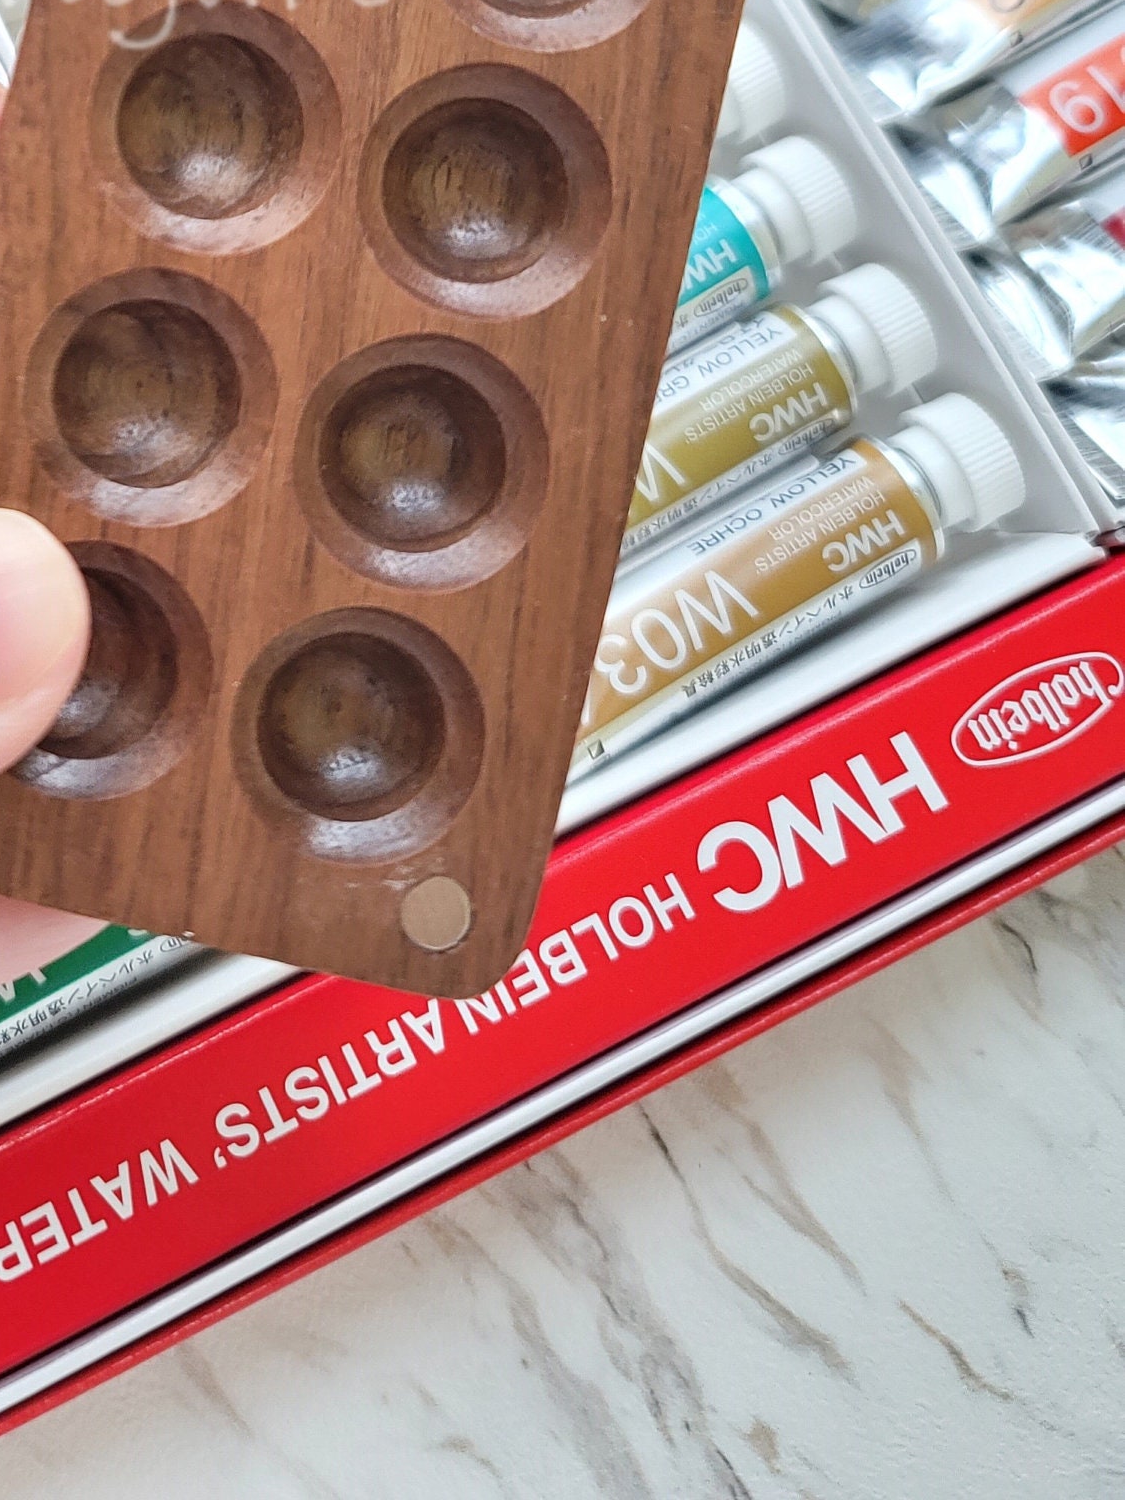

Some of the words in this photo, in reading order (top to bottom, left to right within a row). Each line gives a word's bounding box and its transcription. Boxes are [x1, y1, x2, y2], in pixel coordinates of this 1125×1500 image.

[1049, 47, 1125, 135] 19
[681, 239, 736, 292] HW
[699, 325, 782, 378] YELLOW
[699, 348, 802, 412] WATERCOLOR
[746, 362, 813, 407] HOLBEIN
[748, 381, 828, 441] HWC
[769, 455, 855, 508] YELLOW
[769, 474, 874, 542] WATERCOLOR
[817, 490, 885, 535] HOLBEIN
[691, 508, 763, 555] OCHRE
[821, 508, 904, 573] HWC
[586, 569, 759, 723] W03
[965, 658, 1115, 752] holbein
[696, 731, 950, 913] HWC
[452, 872, 696, 1035] HOLBEIN
[213, 998, 446, 1169] ARTISTS'
